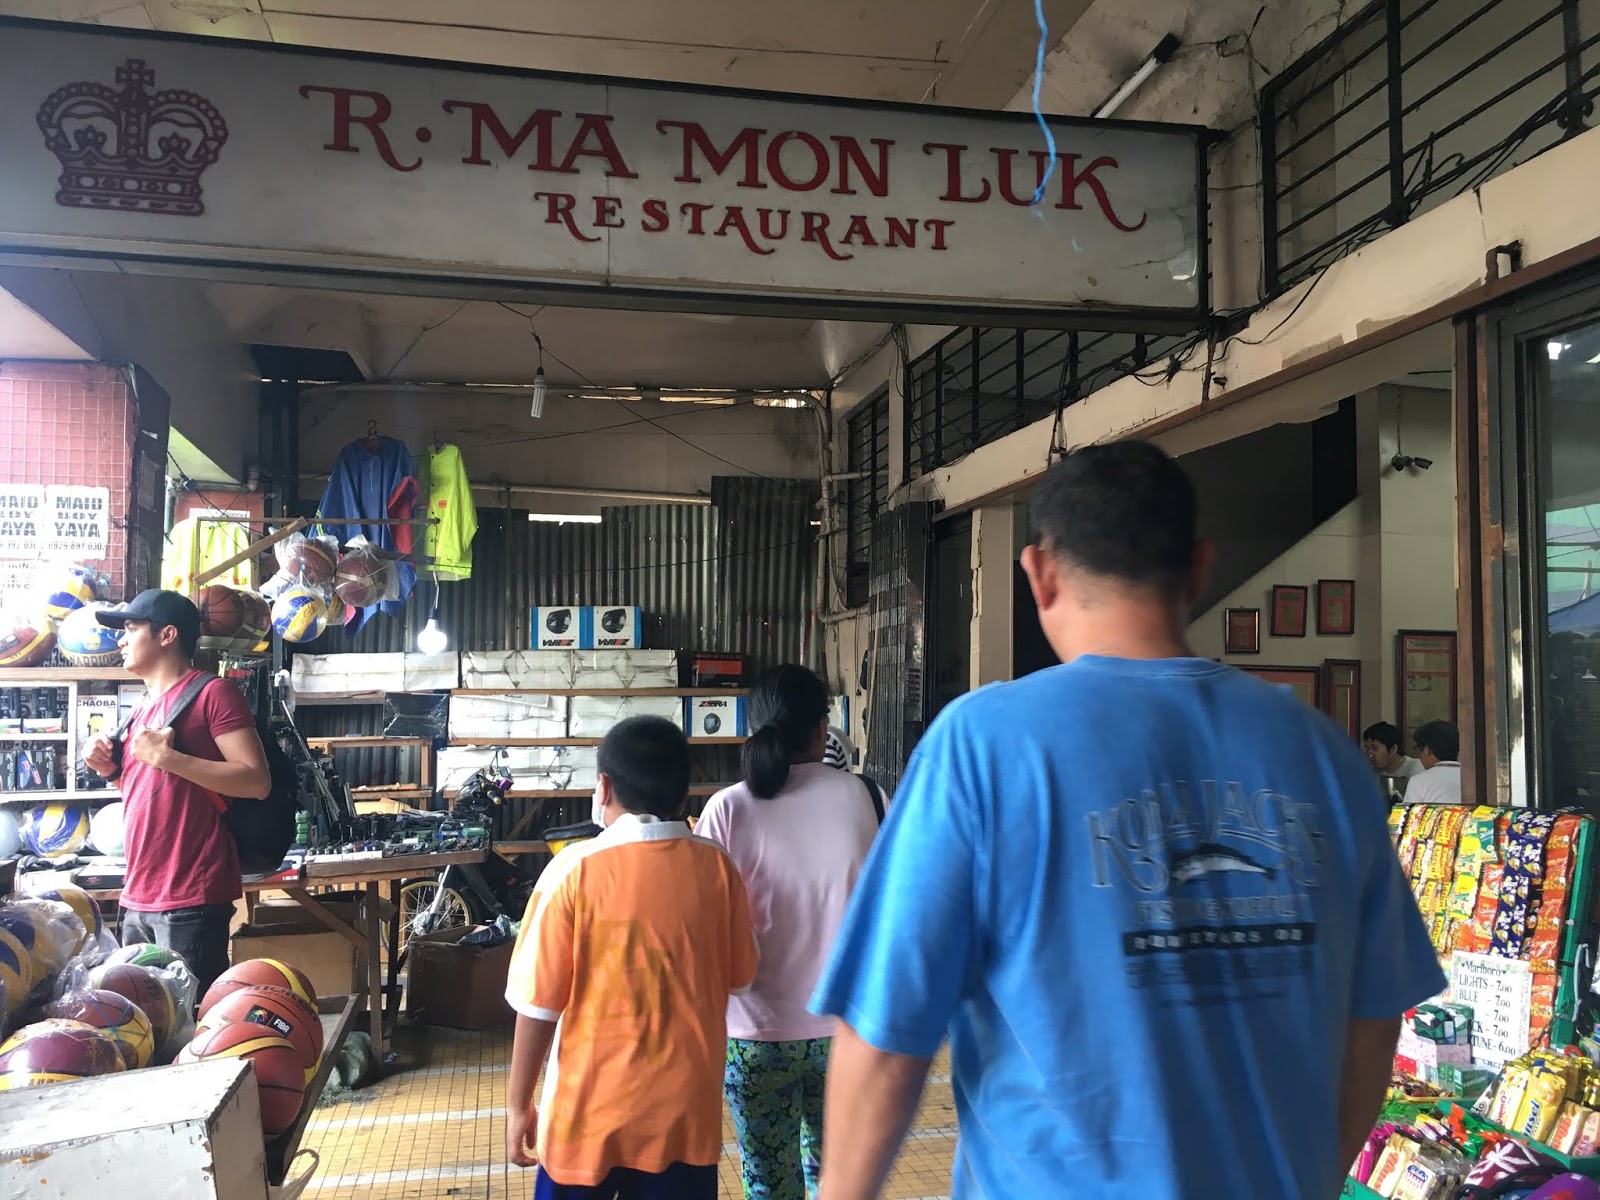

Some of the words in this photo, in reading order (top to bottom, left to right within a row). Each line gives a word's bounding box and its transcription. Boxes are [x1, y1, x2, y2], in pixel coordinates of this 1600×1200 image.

[656, 120, 895, 197] MON
[922, 142, 1147, 232] LUK
[534, 192, 956, 261] RESTAURANT
[56, 496, 103, 510] MAID
[0, 522, 36, 536] AYA
[54, 522, 100, 538] YAYA
[1465, 960, 1500, 976] Marlboro
[1459, 974, 1488, 989] LIGHTS
[1459, 988, 1478, 1003] BLUE
[273, 1018, 290, 1033] FIBA
[1471, 1034, 1492, 1051] TUNE
